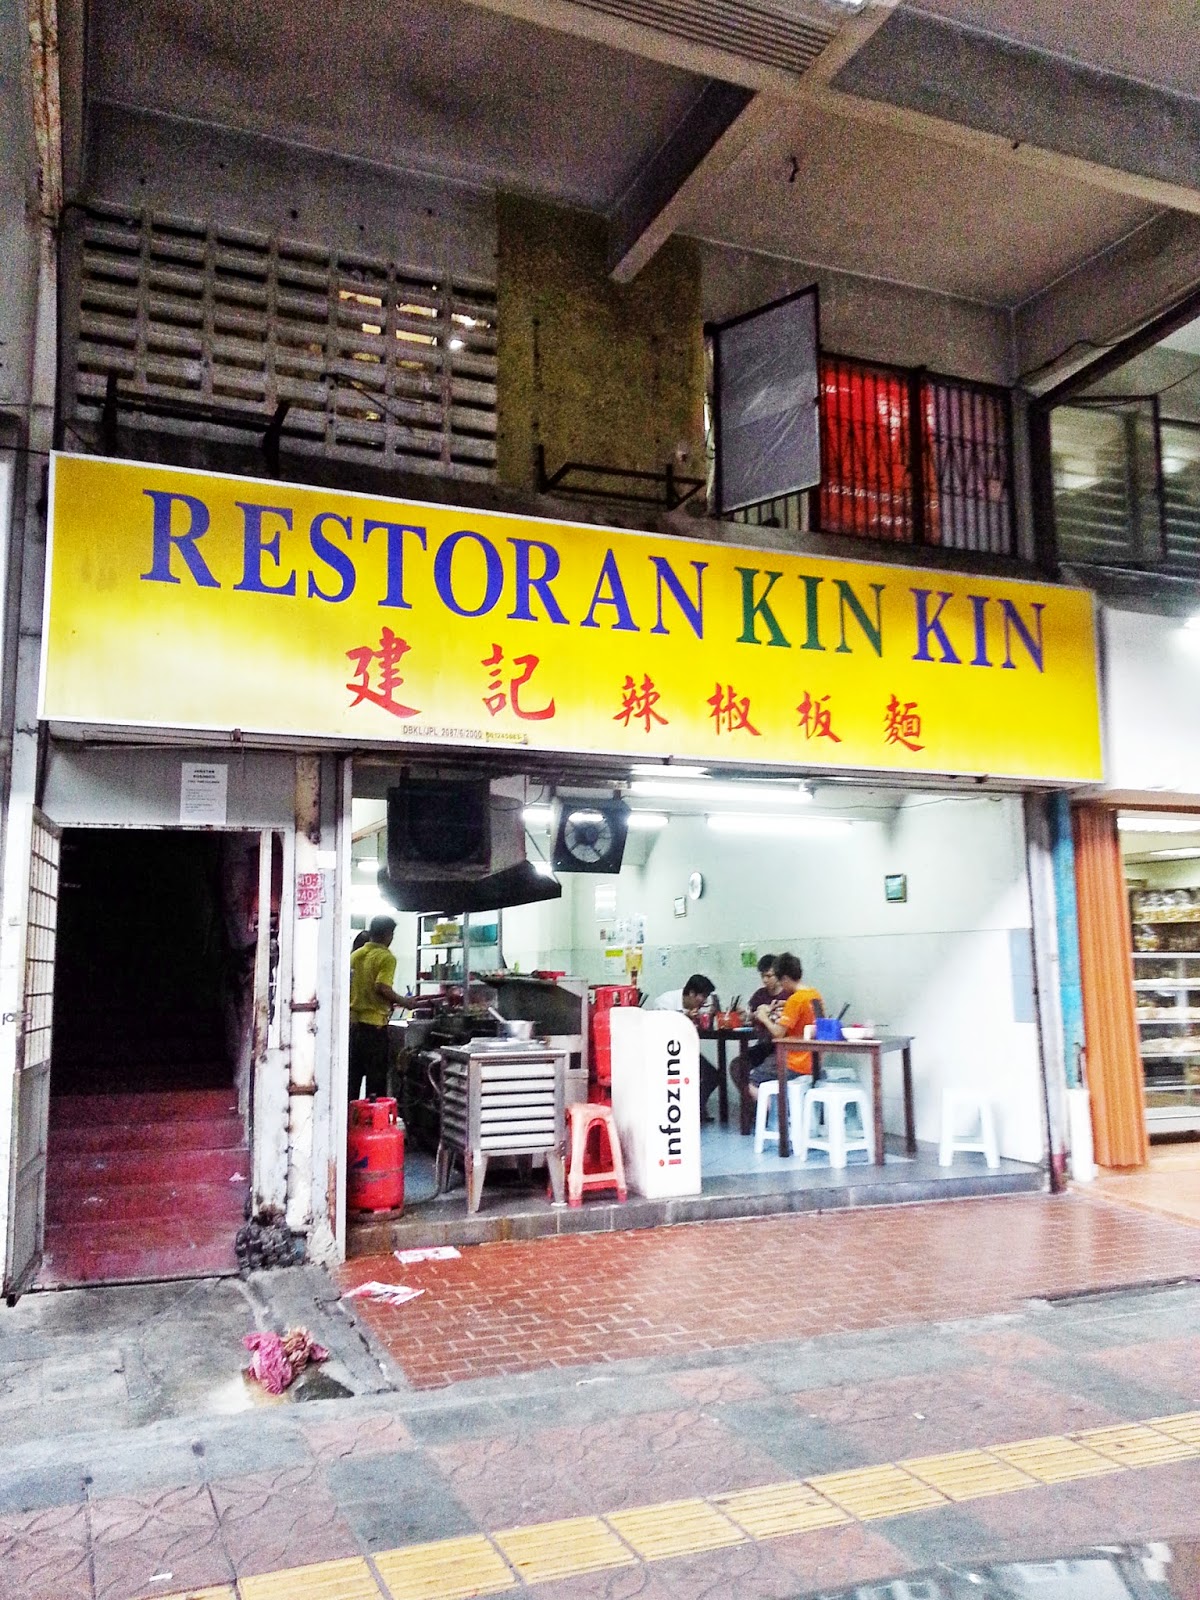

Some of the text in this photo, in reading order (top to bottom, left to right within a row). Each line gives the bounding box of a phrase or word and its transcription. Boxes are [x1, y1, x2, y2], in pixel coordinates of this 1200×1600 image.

[140, 488, 1046, 673] RESTORAN KIN KIN
[345, 626, 925, 753] 建記 辣椒板麵
[659, 1039, 689, 1167] infozine
